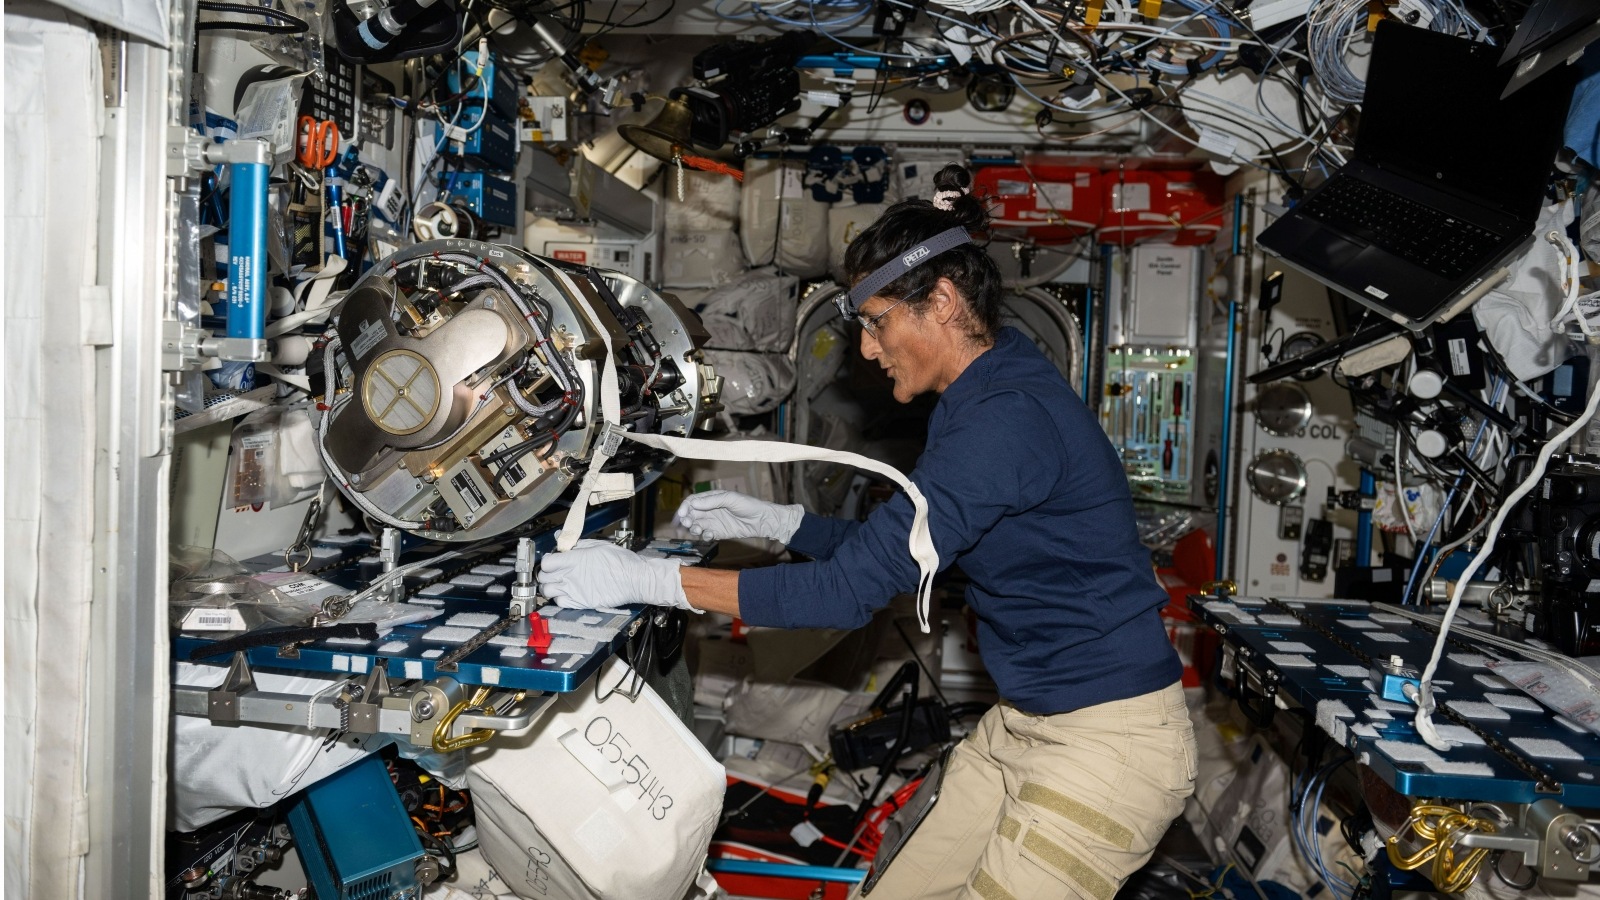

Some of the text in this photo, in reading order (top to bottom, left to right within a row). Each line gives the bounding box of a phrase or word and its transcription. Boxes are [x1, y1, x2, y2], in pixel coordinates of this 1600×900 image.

[557, 251, 584, 261] WATER
[904, 246, 930, 266] PETZL
[1310, 425, 1341, 440] COL
[288, 582, 305, 590] CDM
[584, 716, 674, 821] 05-5443
